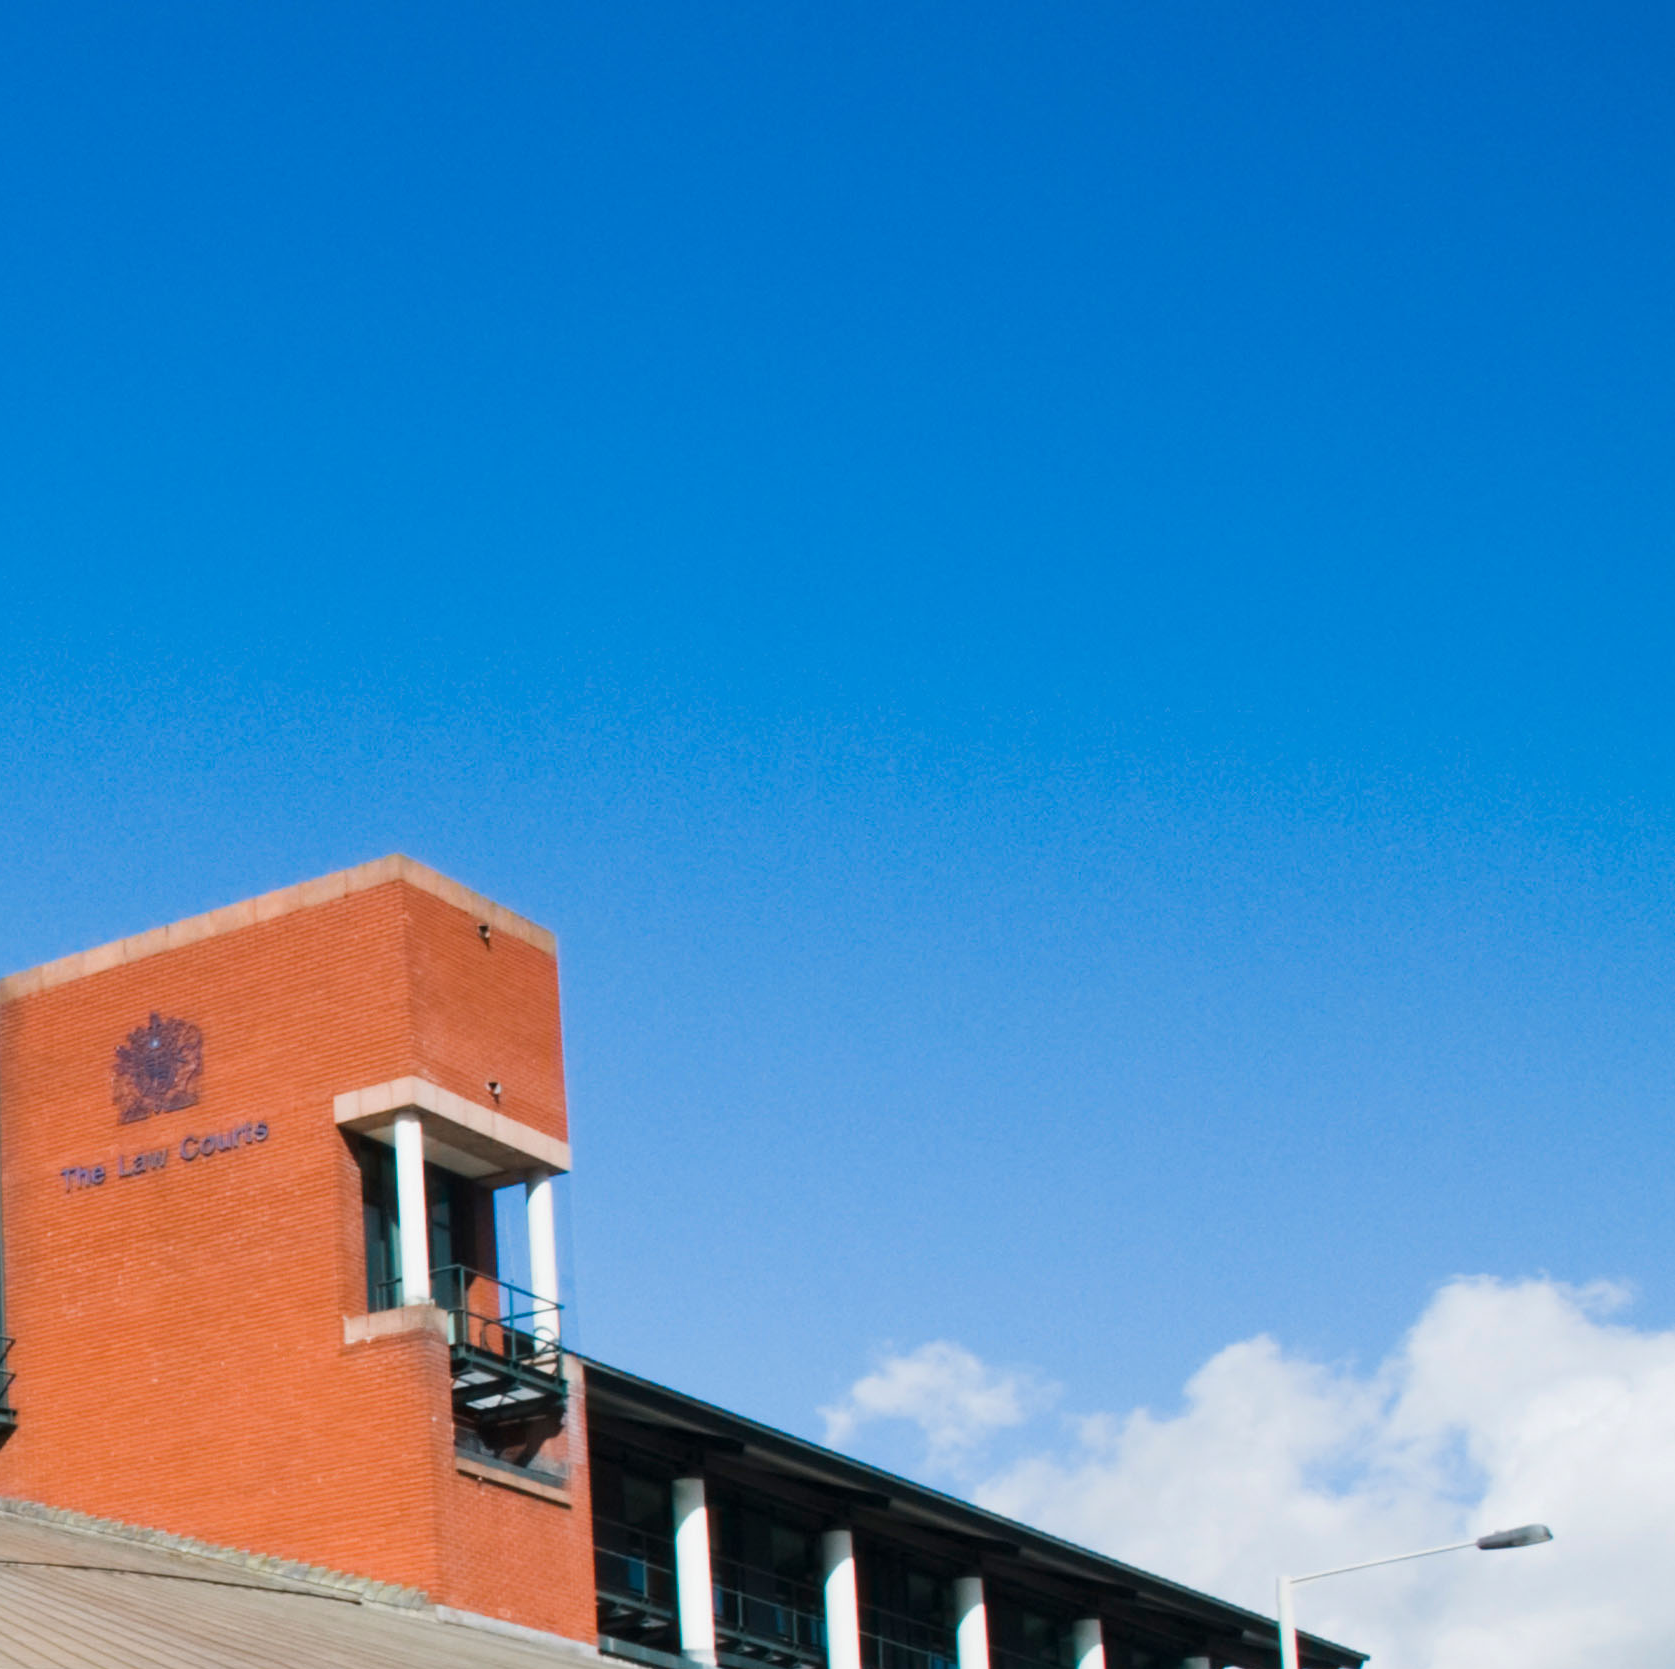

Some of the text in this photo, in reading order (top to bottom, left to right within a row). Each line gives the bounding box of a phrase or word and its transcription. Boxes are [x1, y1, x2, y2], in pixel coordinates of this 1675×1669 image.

[61, 1122, 269, 1193] The Law Courts
